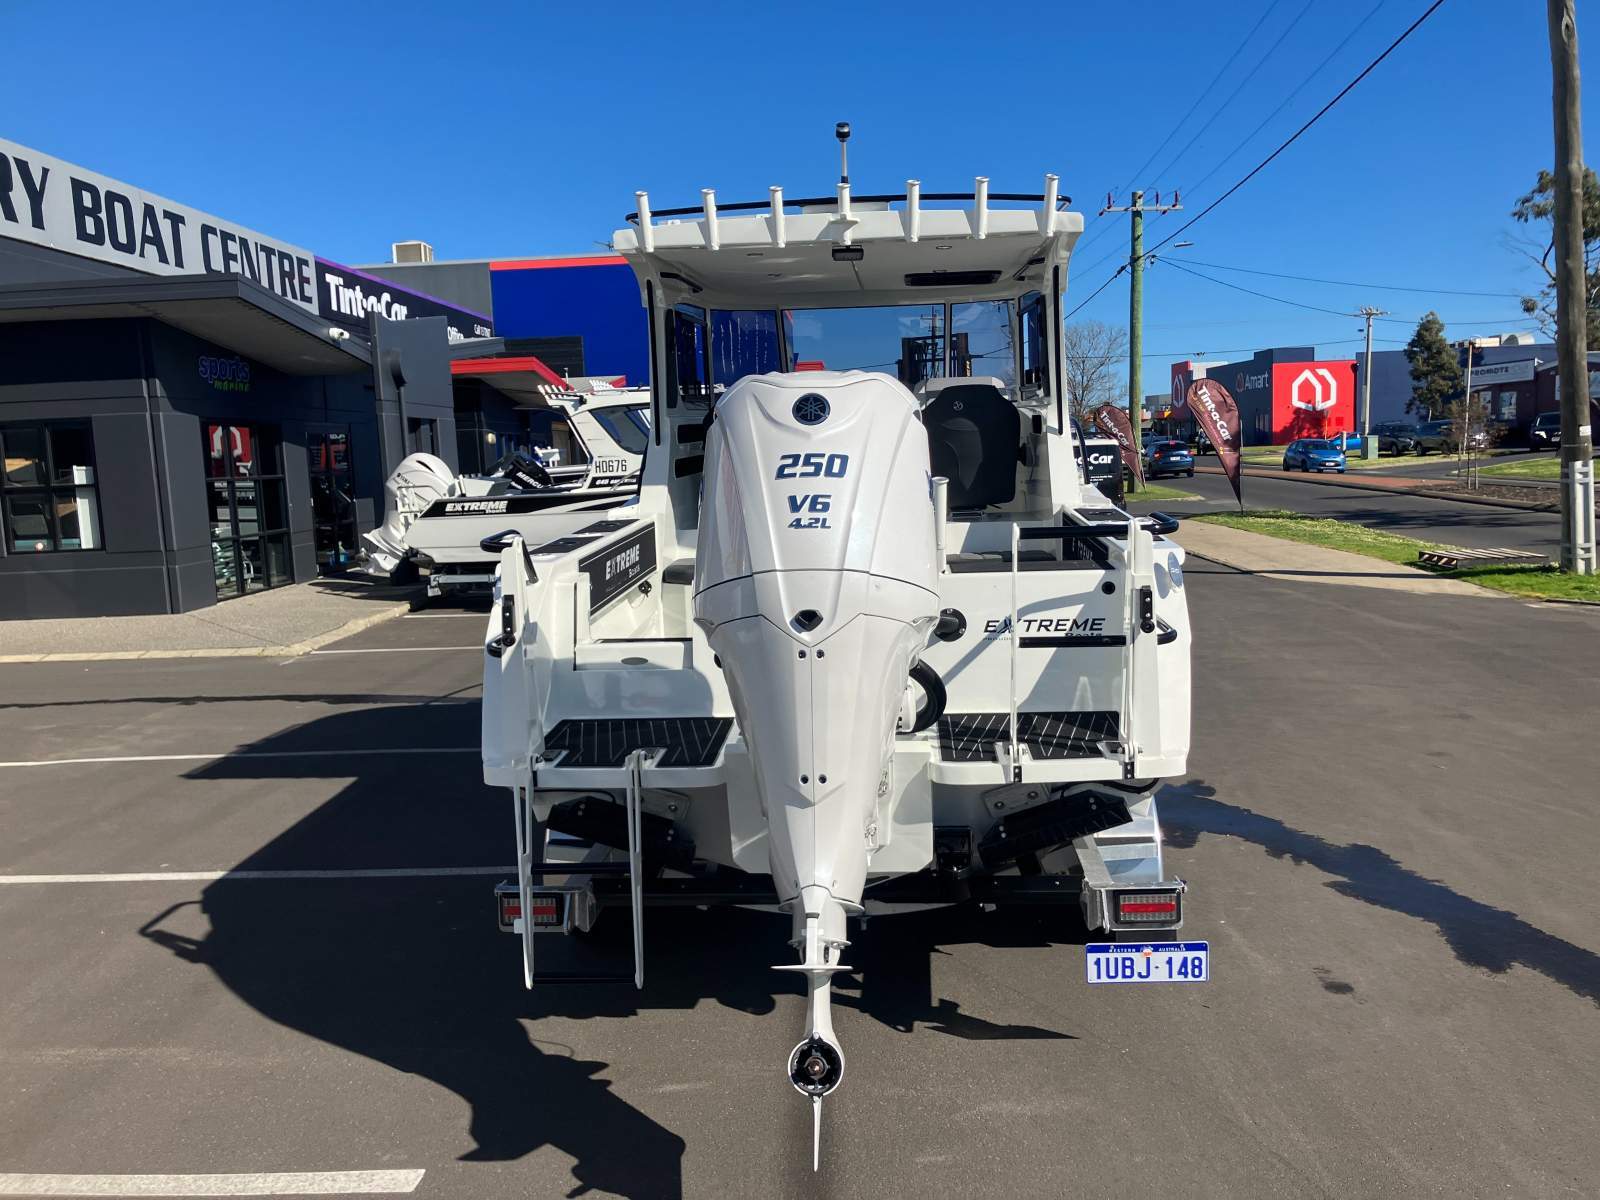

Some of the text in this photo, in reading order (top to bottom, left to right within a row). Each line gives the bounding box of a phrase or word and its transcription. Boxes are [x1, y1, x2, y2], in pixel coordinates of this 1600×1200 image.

[70, 176, 186, 269] BOAT
[201, 223, 313, 304] CENTRE
[1244, 370, 1269, 390] Amart
[775, 453, 849, 480] 250
[445, 500, 508, 512] EXTREME
[787, 494, 832, 513] V6
[787, 517, 832, 529] 4.2L
[605, 543, 640, 581] EXTREME
[983, 617, 1106, 634] EXTREME
